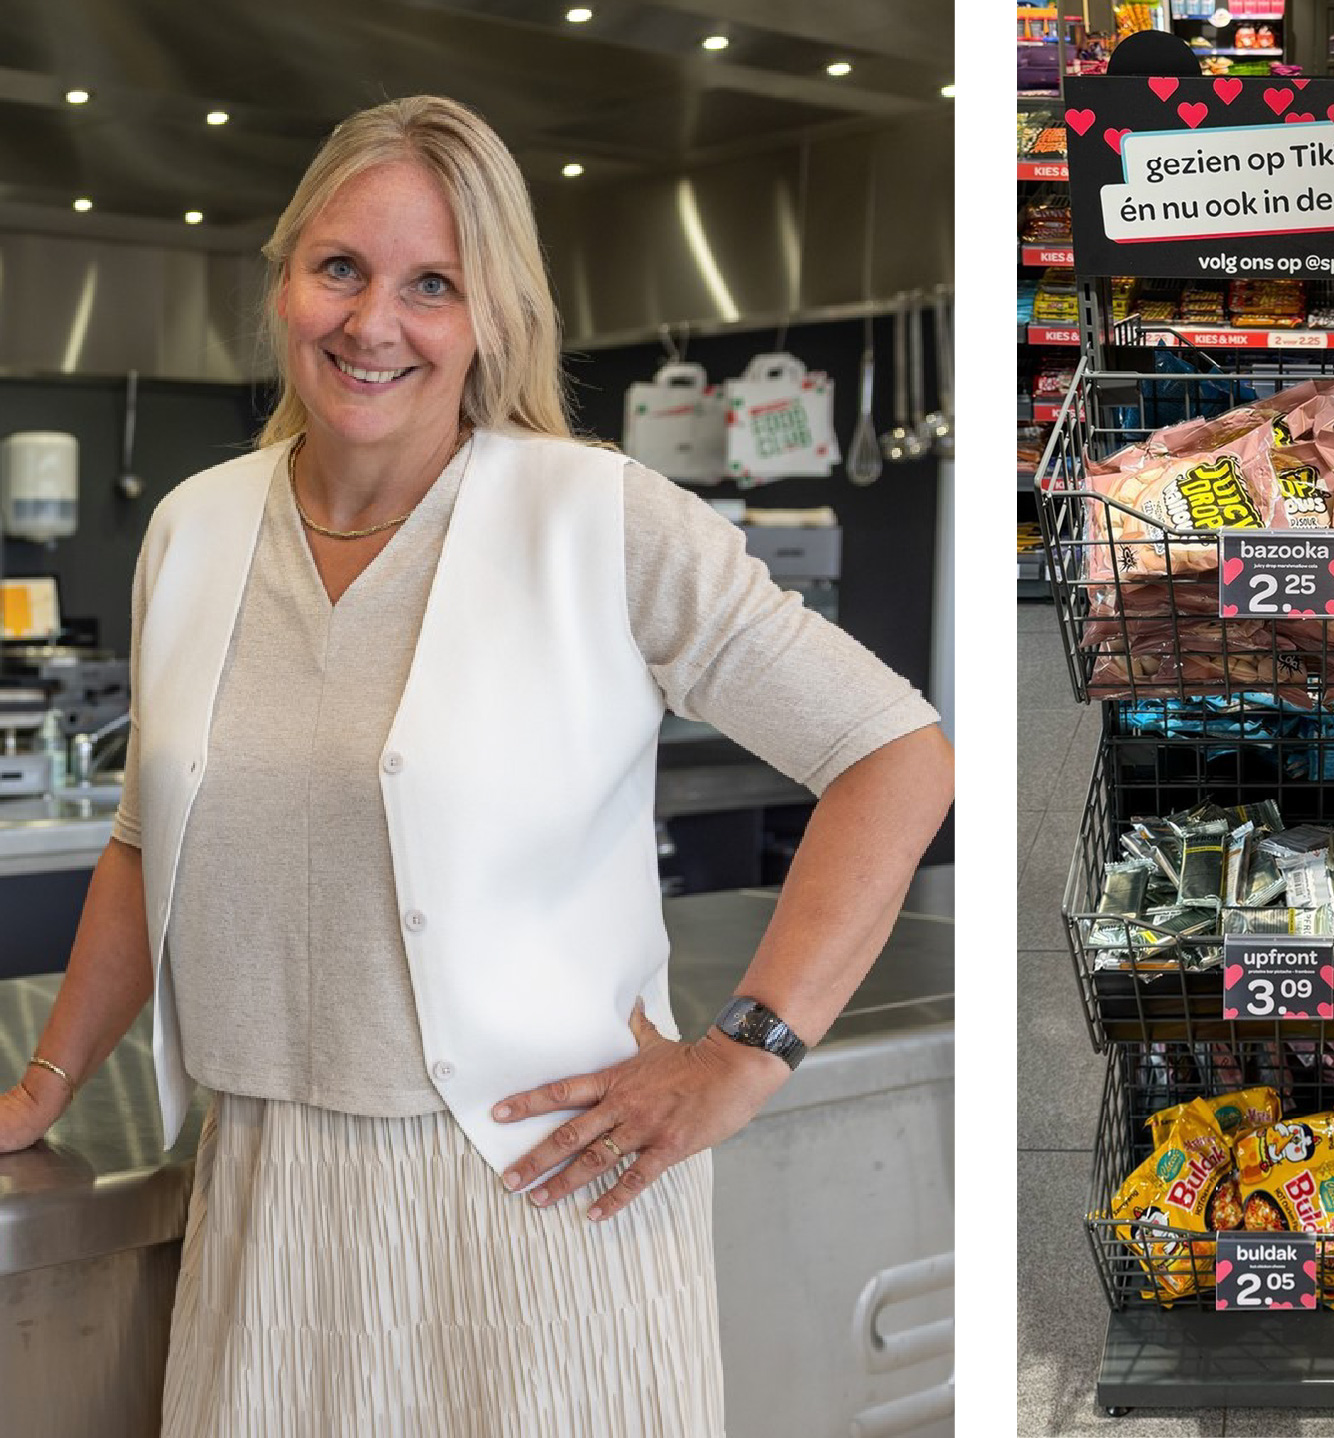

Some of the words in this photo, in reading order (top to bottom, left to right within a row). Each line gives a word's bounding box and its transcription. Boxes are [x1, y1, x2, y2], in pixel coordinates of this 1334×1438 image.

[1034, 166, 1059, 176] KIES
[1061, 167, 1069, 176] &
[1146, 149, 1241, 183] gezien
[1247, 150, 1285, 176] op
[1119, 196, 1155, 222] én
[1163, 200, 1198, 220] nu
[1205, 191, 1258, 217] ook
[1264, 189, 1290, 213] in
[1296, 187, 1332, 211] de
[1041, 253, 1065, 262] KIES
[1199, 253, 1237, 273] volg
[1240, 256, 1274, 271] ons
[1277, 256, 1302, 274] op
[1046, 332, 1070, 341] KIES
[1195, 335, 1218, 344] KIES
[1219, 335, 1228, 344] &
[1229, 335, 1248, 345] MIX
[1274, 337, 1282, 346] 2
[1241, 540, 1329, 558] bazooka
[1244, 949, 1318, 969] upfront
[1237, 1245, 1297, 1260] buldak
